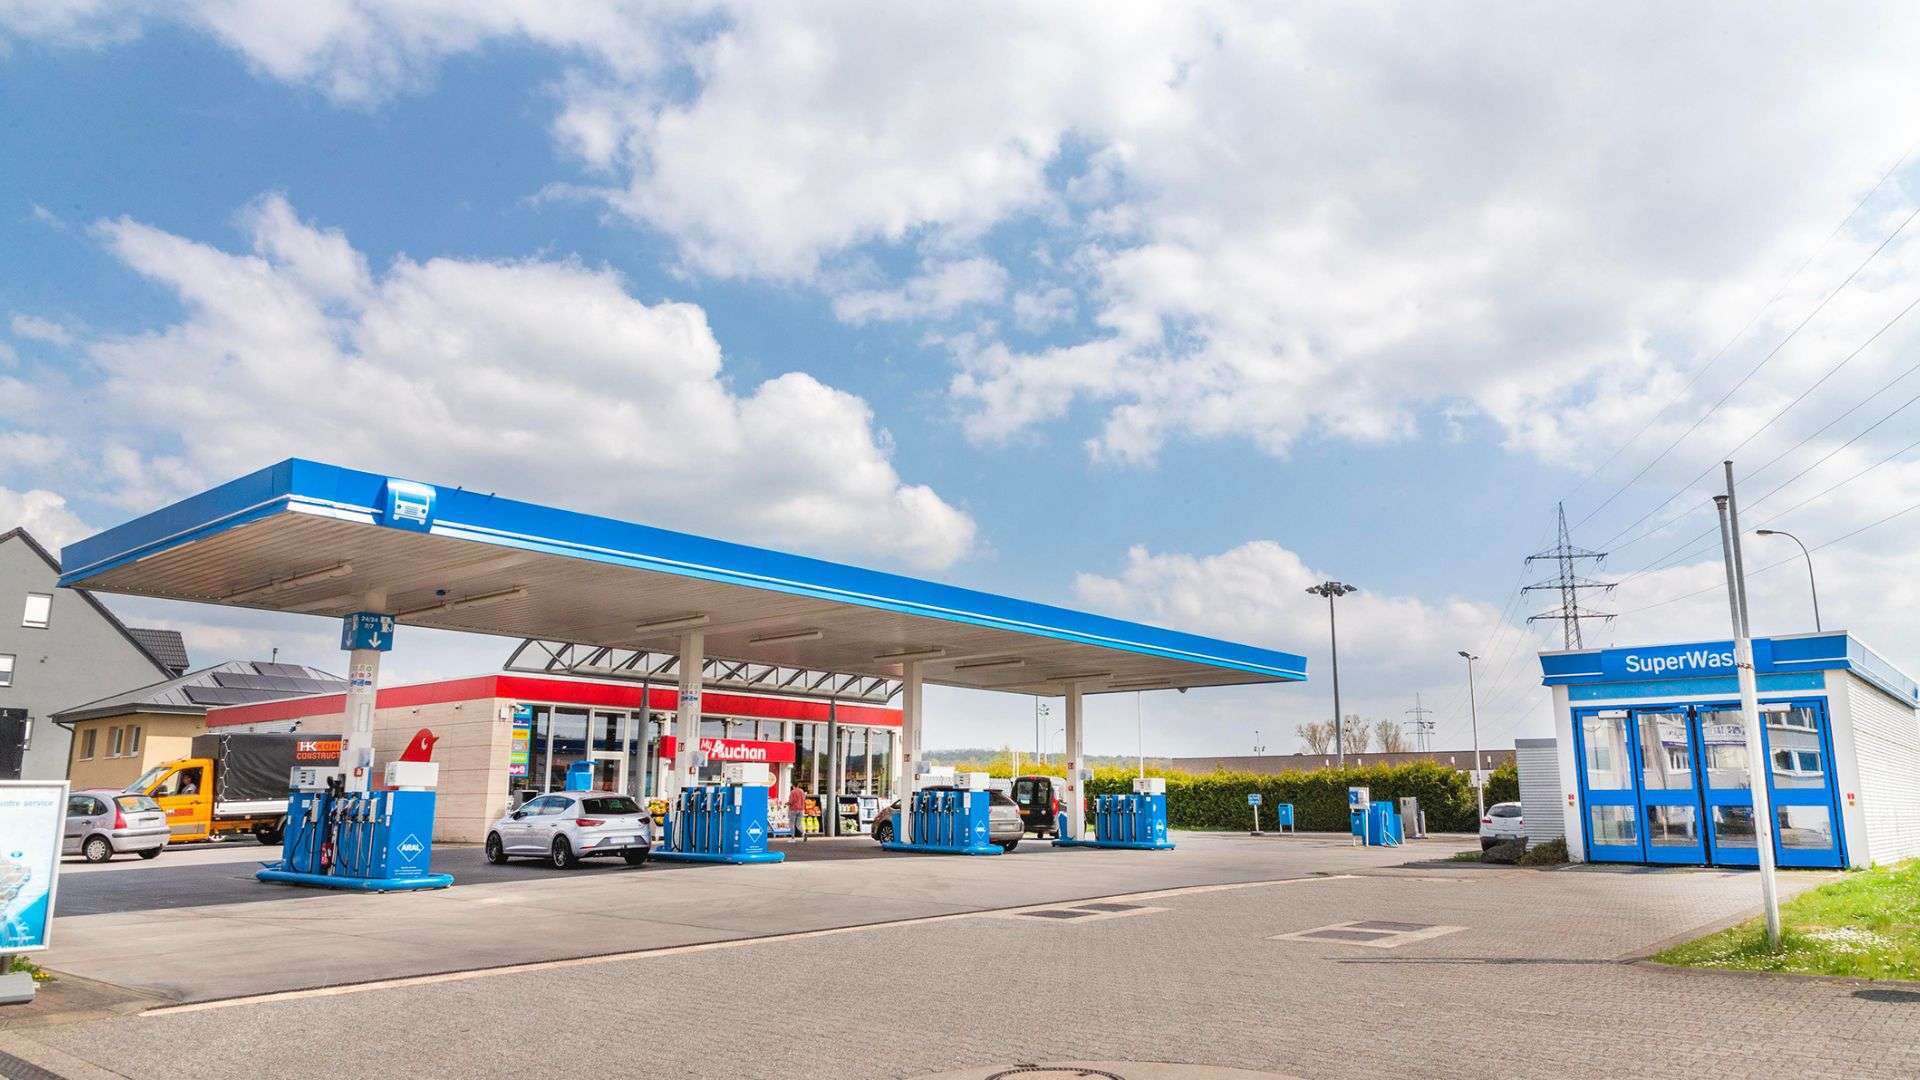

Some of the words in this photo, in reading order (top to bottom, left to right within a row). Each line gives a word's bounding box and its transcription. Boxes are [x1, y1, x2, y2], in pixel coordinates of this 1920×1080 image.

[701, 739, 713, 753] My
[712, 740, 767, 761] Auchan
[401, 844, 421, 852] ARAL
